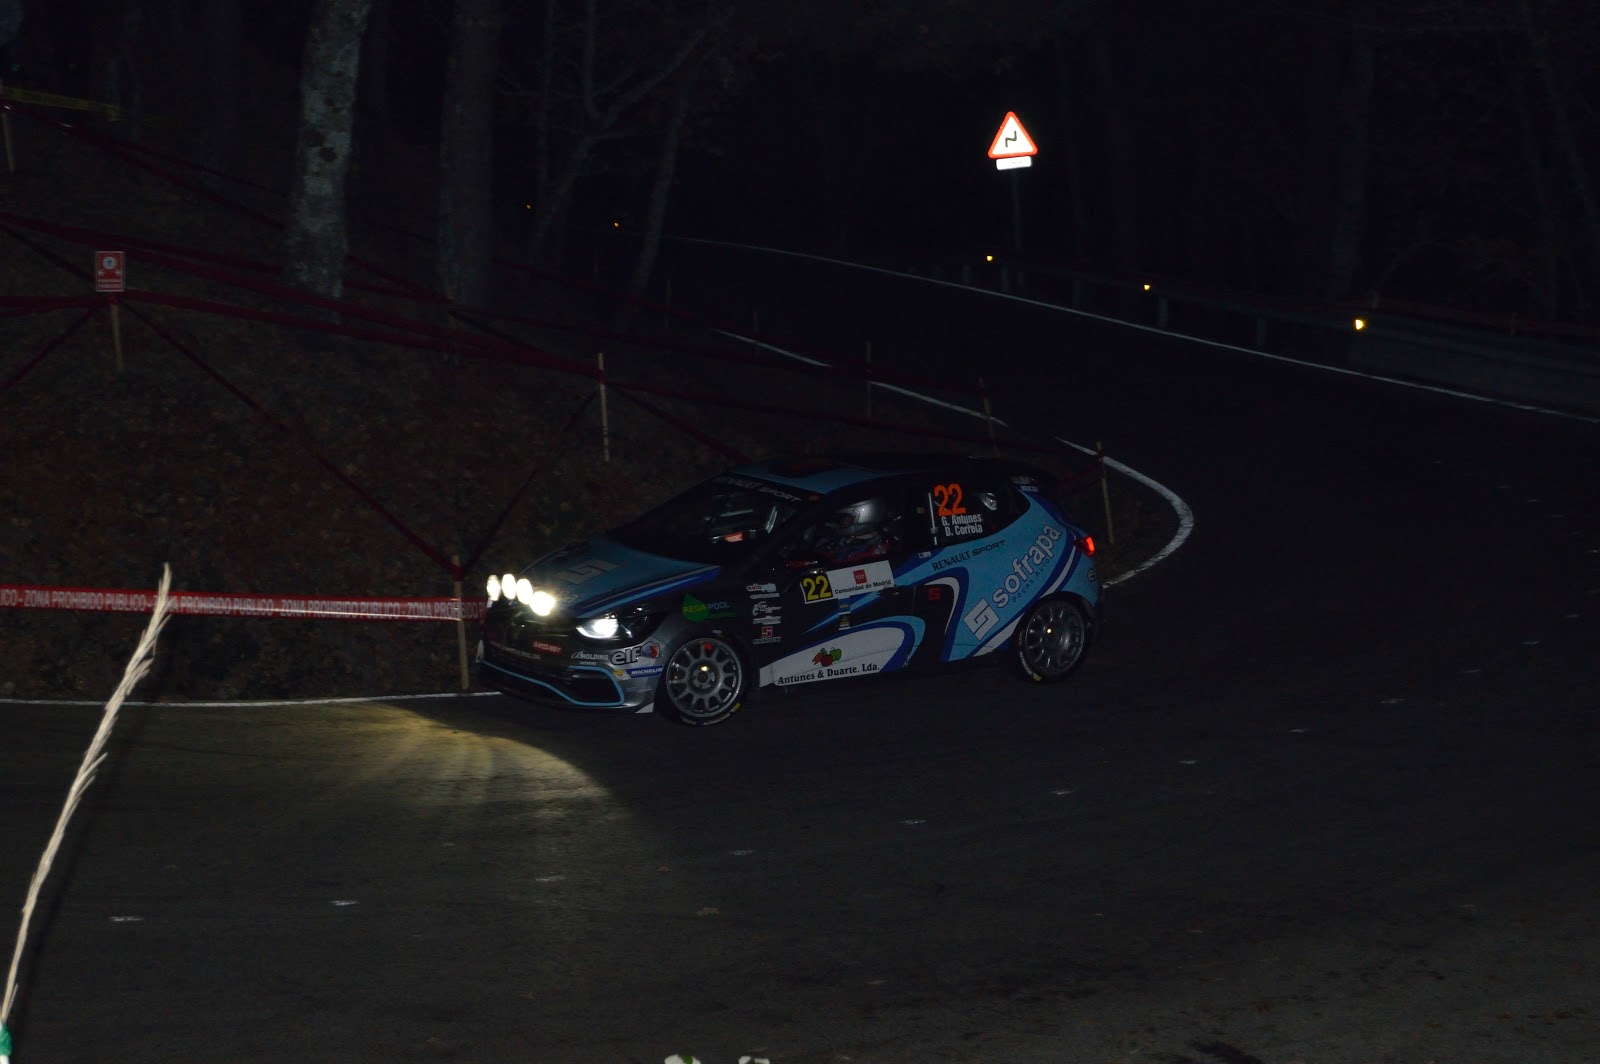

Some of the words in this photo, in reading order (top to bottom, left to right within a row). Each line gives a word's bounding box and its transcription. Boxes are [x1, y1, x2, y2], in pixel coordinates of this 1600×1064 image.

[932, 482, 968, 516] 22
[932, 551, 970, 571] RENAULT
[971, 540, 1006, 557] SPORT
[992, 525, 1061, 608] sofrapa
[802, 575, 833, 602] 22
[834, 585, 864, 594] Comunidad
[24, 590, 50, 607] ZONA
[52, 591, 103, 609] PROHIBIDO
[105, 593, 146, 611] PUBLICO
[181, 596, 230, 614] PROHIBIDO
[233, 597, 273, 615] PUBLICO
[280, 599, 305, 617] ZONA
[308, 600, 358, 618] PROHIBIDO
[408, 602, 431, 619] ZONA
[682, 603, 706, 613] REGA
[708, 601, 730, 610] POOL
[610, 645, 642, 665] elf
[631, 667, 663, 675] MICHELIN
[777, 672, 815, 685] Antunes
[817, 669, 824, 678] &
[861, 662, 880, 672] Lda.
